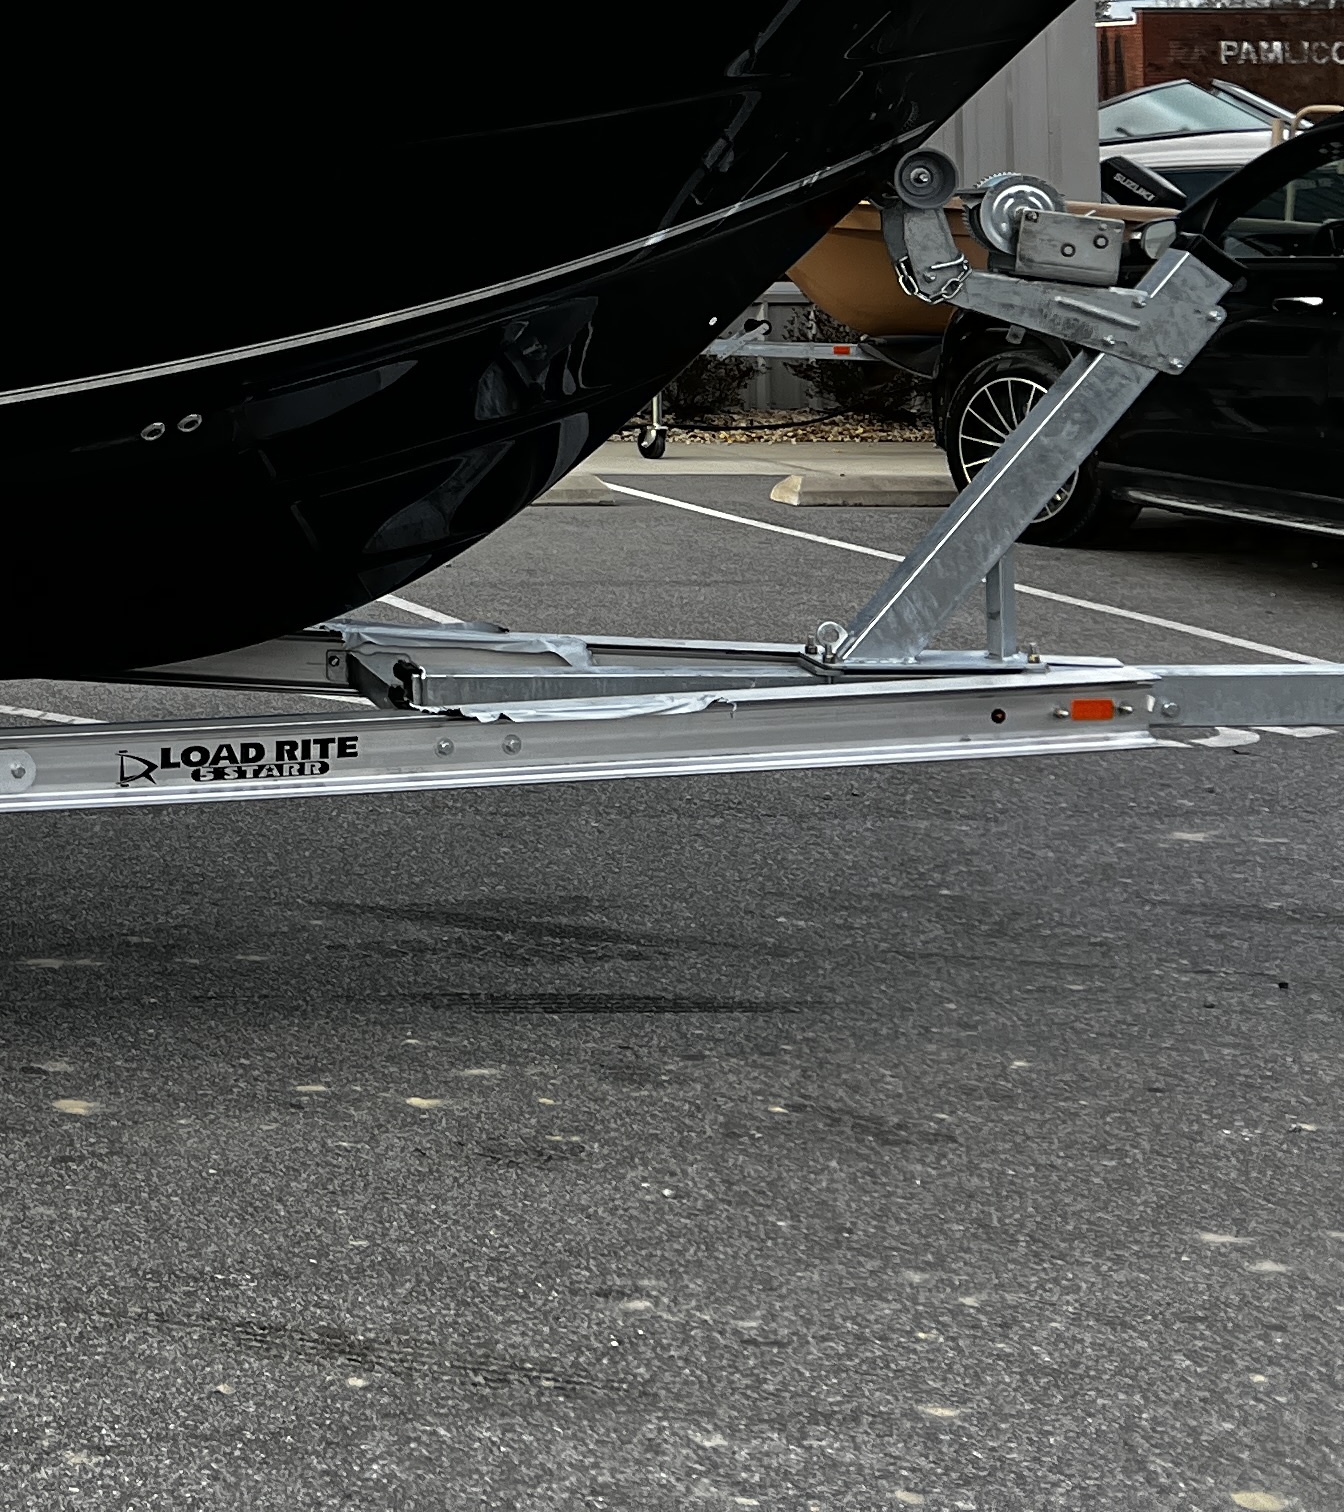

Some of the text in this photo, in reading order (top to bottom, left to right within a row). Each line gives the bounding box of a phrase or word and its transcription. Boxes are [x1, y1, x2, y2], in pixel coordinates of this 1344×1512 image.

[1113, 172, 1156, 202] SUZUKI
[161, 736, 358, 769] LOAD RITE
[199, 767, 215, 781] 5
